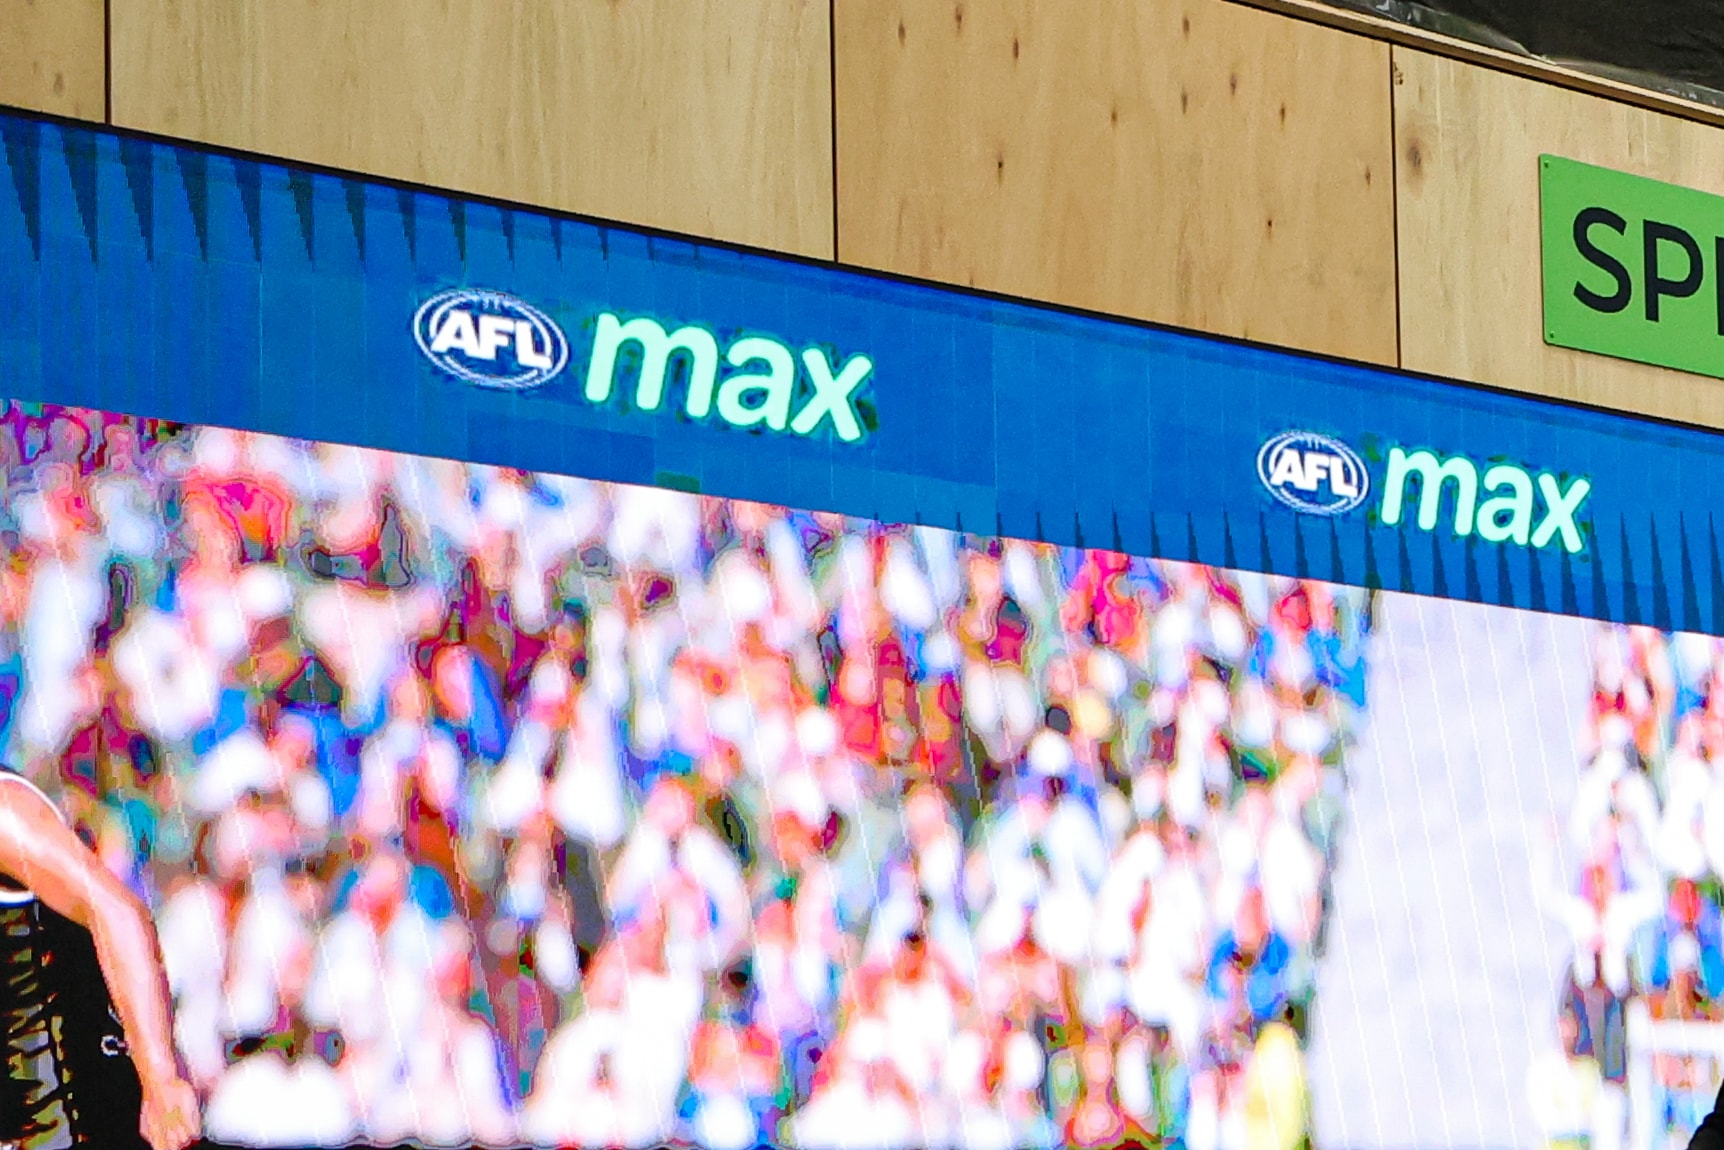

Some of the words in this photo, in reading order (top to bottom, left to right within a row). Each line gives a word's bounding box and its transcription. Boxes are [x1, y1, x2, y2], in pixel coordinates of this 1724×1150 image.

[430, 309, 553, 371] AFL
[584, 312, 873, 442] max
[1269, 448, 1359, 499] AFL
[1381, 446, 1591, 554] max
